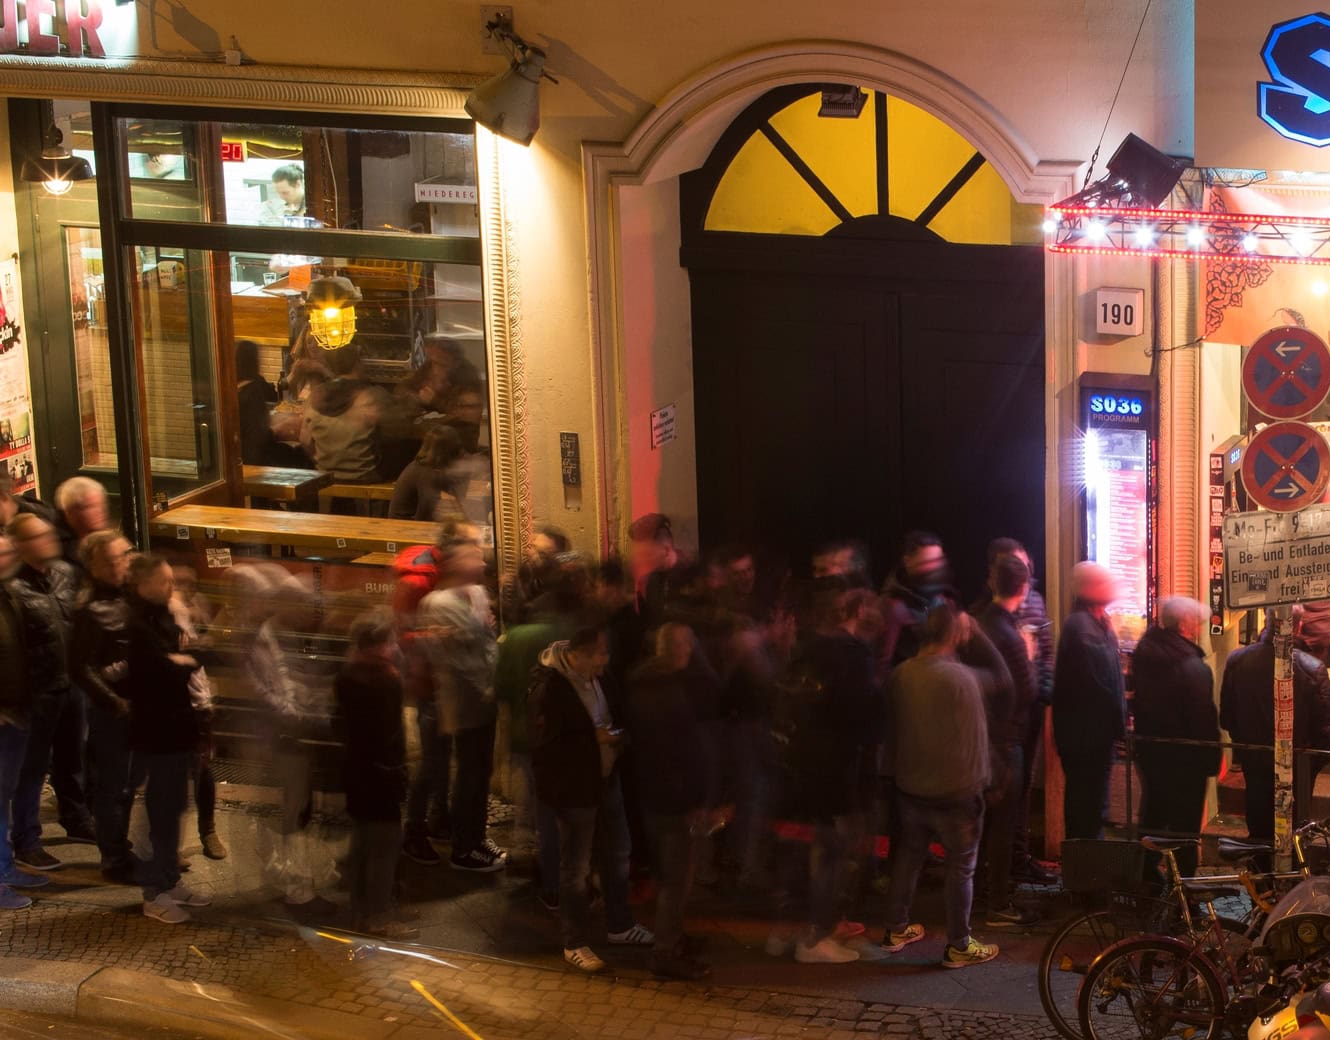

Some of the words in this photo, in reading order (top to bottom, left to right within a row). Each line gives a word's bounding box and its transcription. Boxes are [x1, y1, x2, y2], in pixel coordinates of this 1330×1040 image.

[1102, 303, 1134, 326] 190
[1093, 414, 1140, 424] PROGRAMM
[1239, 551, 1259, 565] Be-
[1263, 546, 1284, 562] und
[1280, 581, 1300, 597] frei
